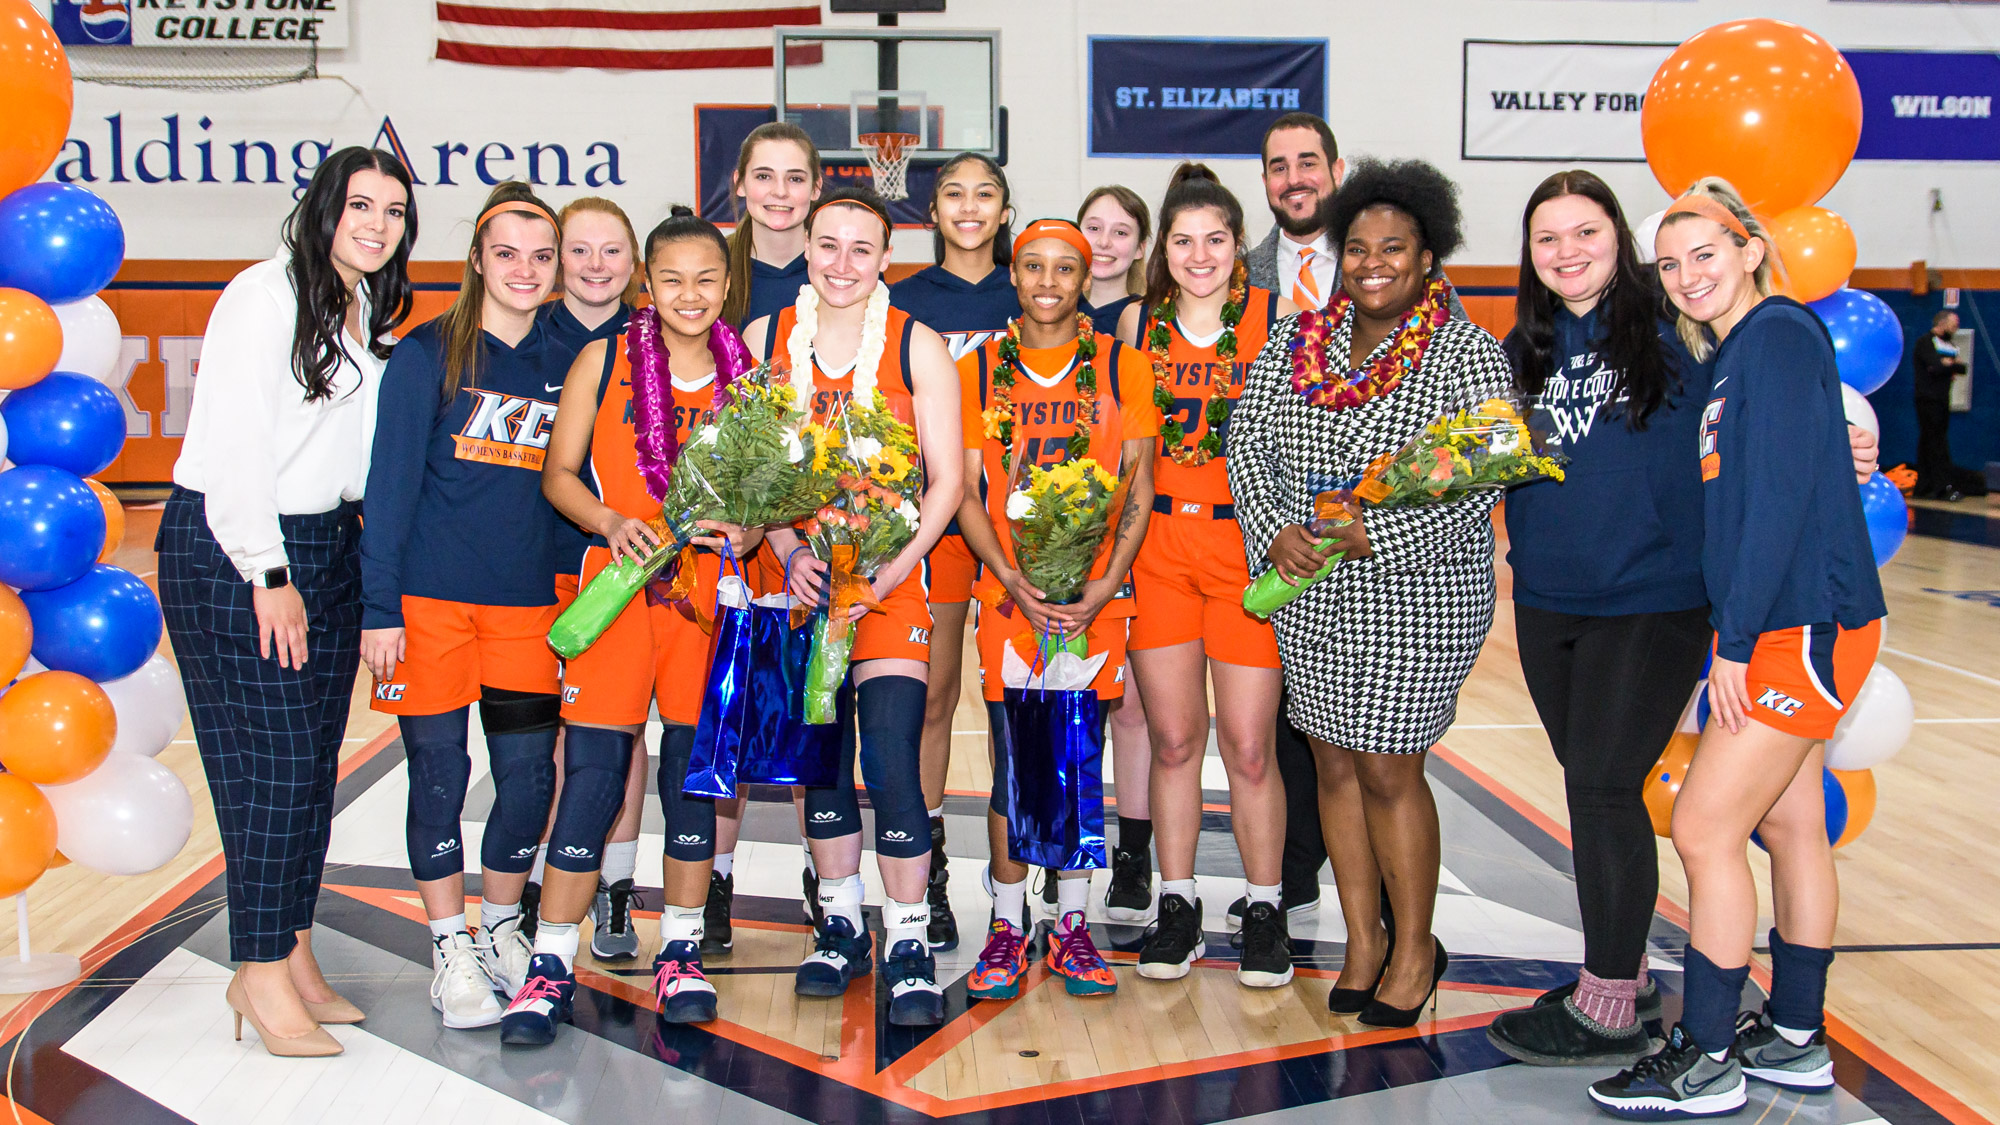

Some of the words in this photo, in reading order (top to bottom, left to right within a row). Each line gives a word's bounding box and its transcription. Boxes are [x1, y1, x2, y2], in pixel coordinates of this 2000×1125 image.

[155, 16, 324, 40] COLLEGE
[1116, 86, 1155, 108] ST.
[1161, 87, 1300, 108] ELIZABETH
[1490, 90, 1588, 111] VALLEY
[1594, 92, 1645, 112] FOR
[1891, 95, 1992, 118] WILSON
[54, 110, 333, 201] alding
[371, 114, 627, 188] Arena
[376, 682, 407, 700] KC
[1756, 686, 1805, 717] KC
